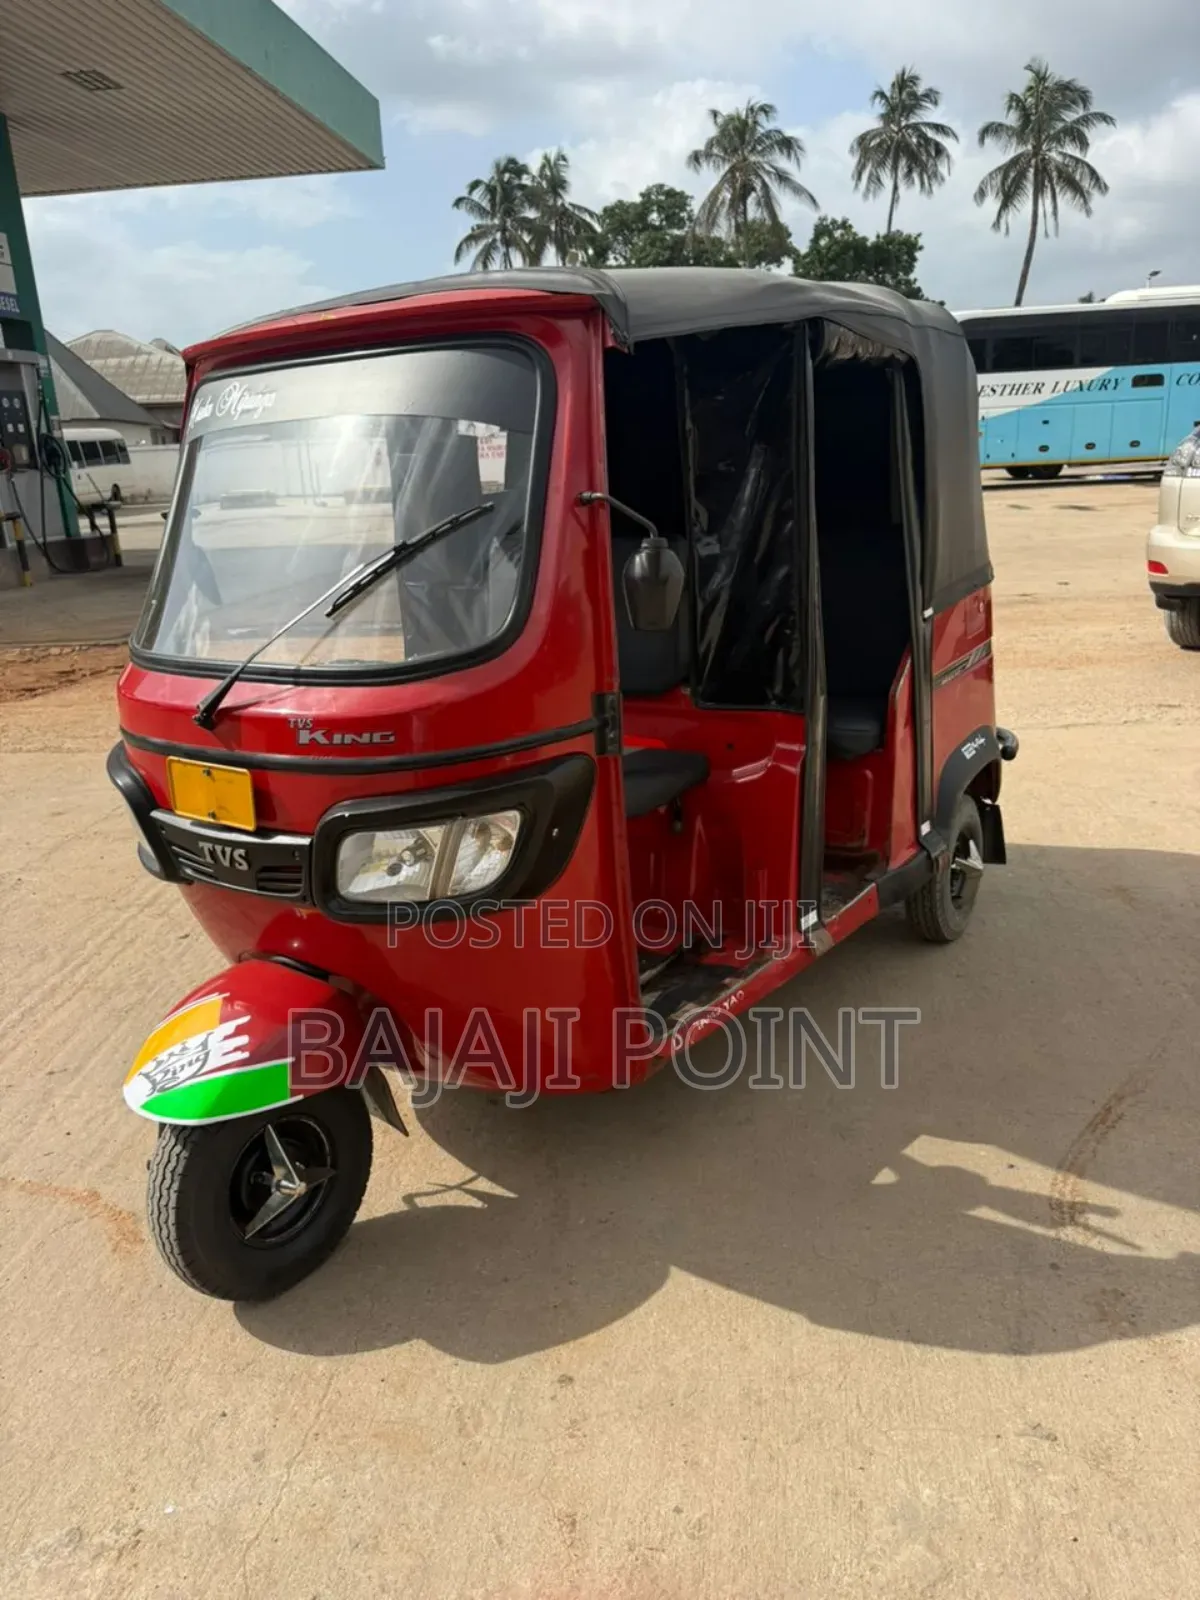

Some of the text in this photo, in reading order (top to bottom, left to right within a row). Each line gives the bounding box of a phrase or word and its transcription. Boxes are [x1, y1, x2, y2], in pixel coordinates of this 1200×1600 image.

[978, 381, 1046, 398] ESTHER
[1050, 376, 1125, 394] LUXURY
[288, 718, 314, 729] TVS
[298, 729, 396, 746] KING
[198, 841, 249, 871] TVS
